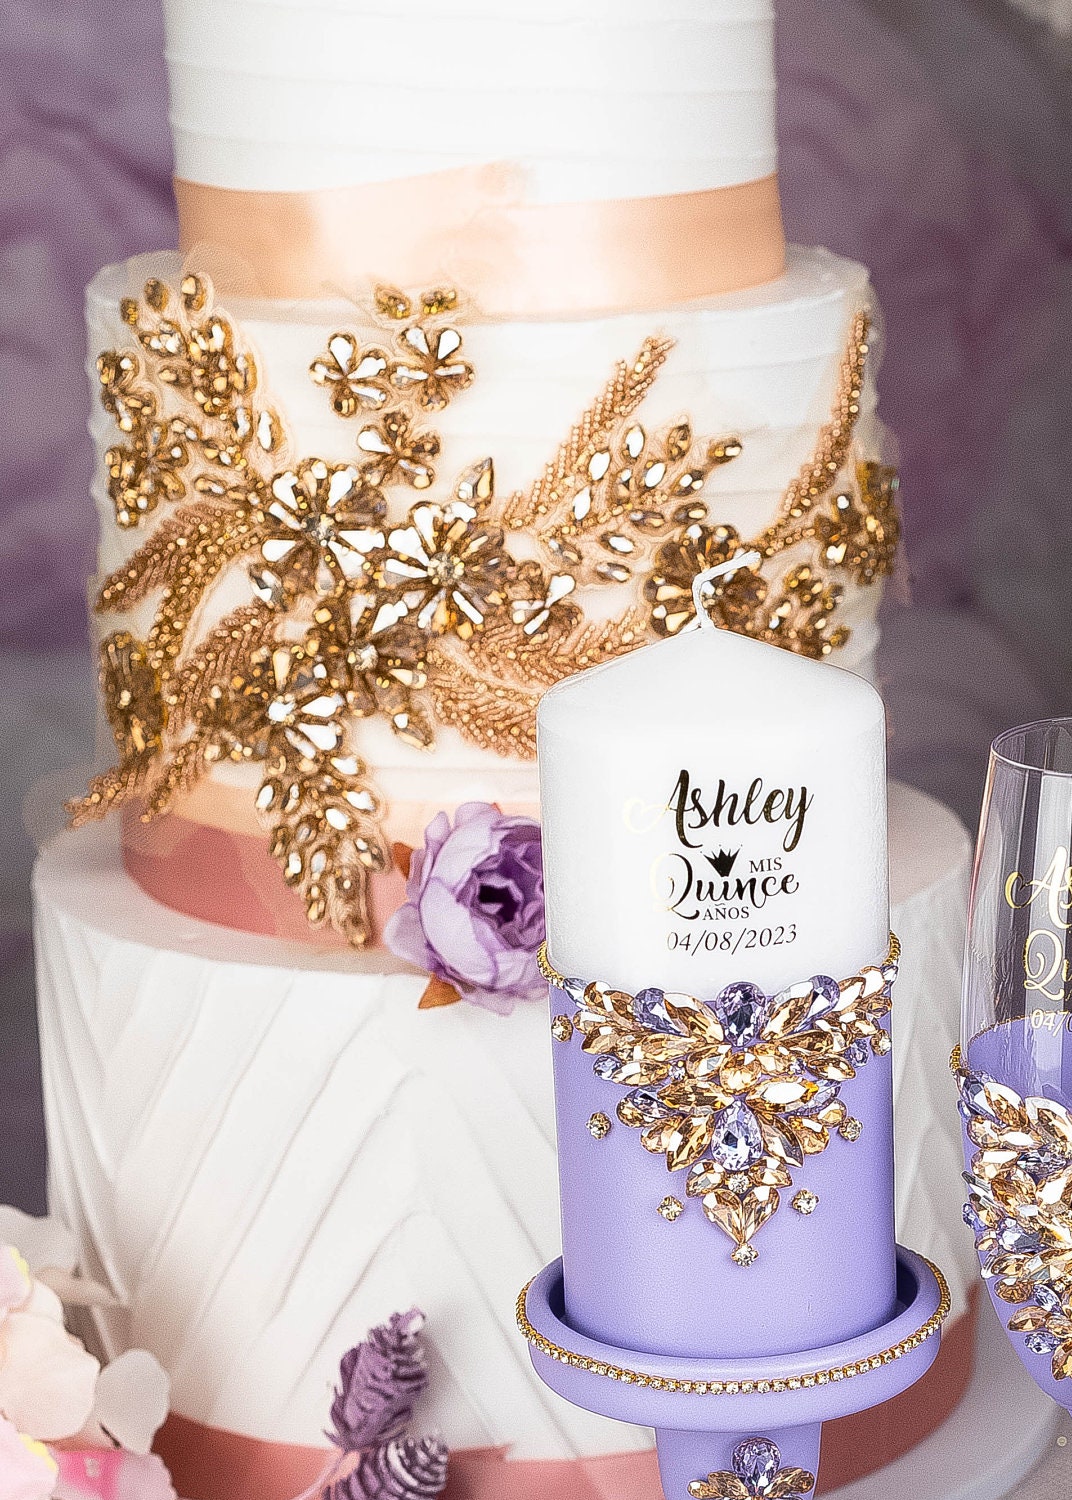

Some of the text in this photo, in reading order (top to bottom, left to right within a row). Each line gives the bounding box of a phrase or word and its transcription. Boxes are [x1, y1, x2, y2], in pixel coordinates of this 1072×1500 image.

[623, 769, 814, 852] Ashley
[749, 857, 782, 873] MIS
[652, 853, 800, 920] Quince
[702, 903, 750, 921] AÑOS
[667, 924, 797, 956] 04/08/2023
